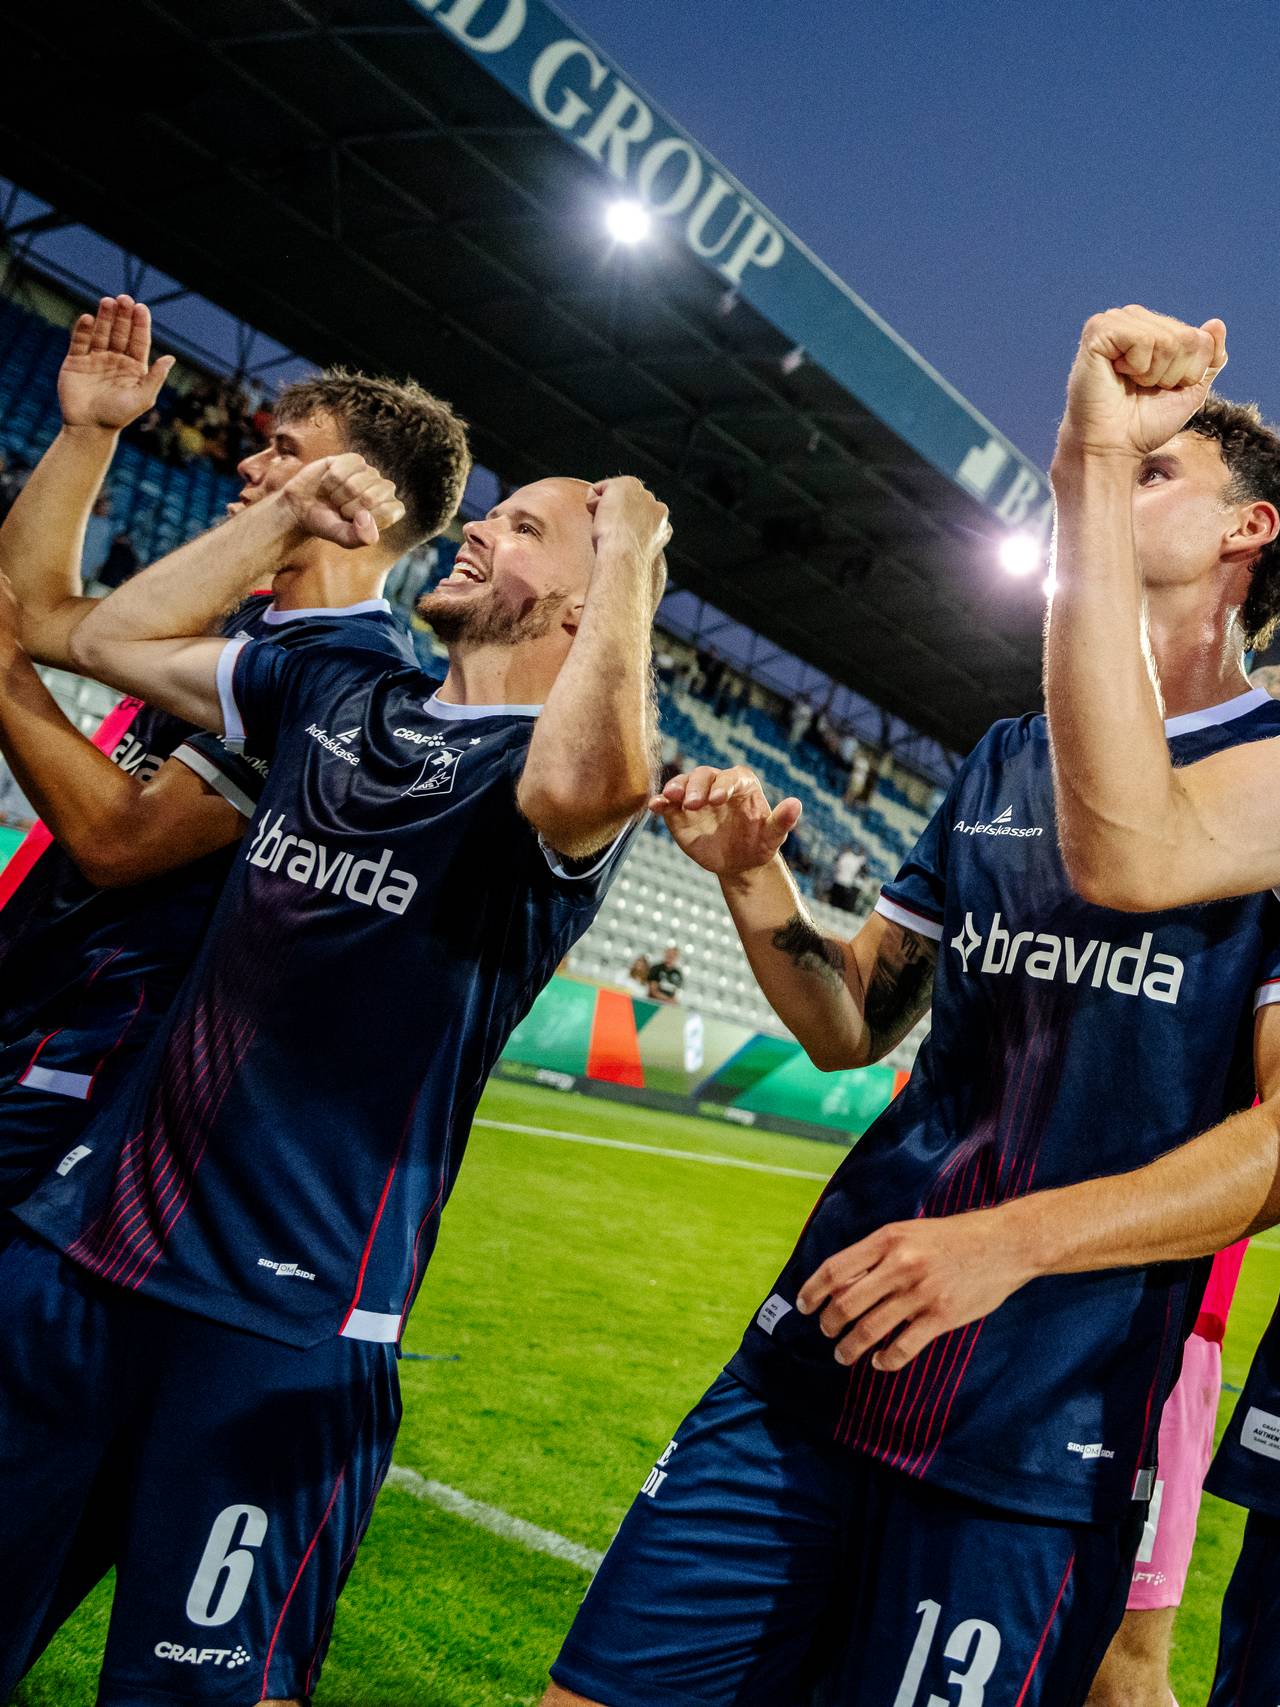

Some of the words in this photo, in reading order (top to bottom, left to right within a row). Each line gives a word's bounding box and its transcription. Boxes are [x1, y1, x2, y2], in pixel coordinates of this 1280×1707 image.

[416, 0, 528, 54] D
[528, 38, 786, 281] GROUP
[392, 727, 434, 745] CRAF
[249, 813, 419, 916] bravida
[980, 912, 1185, 1005] bravida
[257, 1258, 280, 1270] SIDE
[294, 1269, 316, 1281] SIDE
[1066, 1441, 1085, 1453] SIDE
[186, 1504, 268, 1627] 6
[154, 1641, 232, 1666] CRAFT
[892, 1598, 1002, 1707] 13
